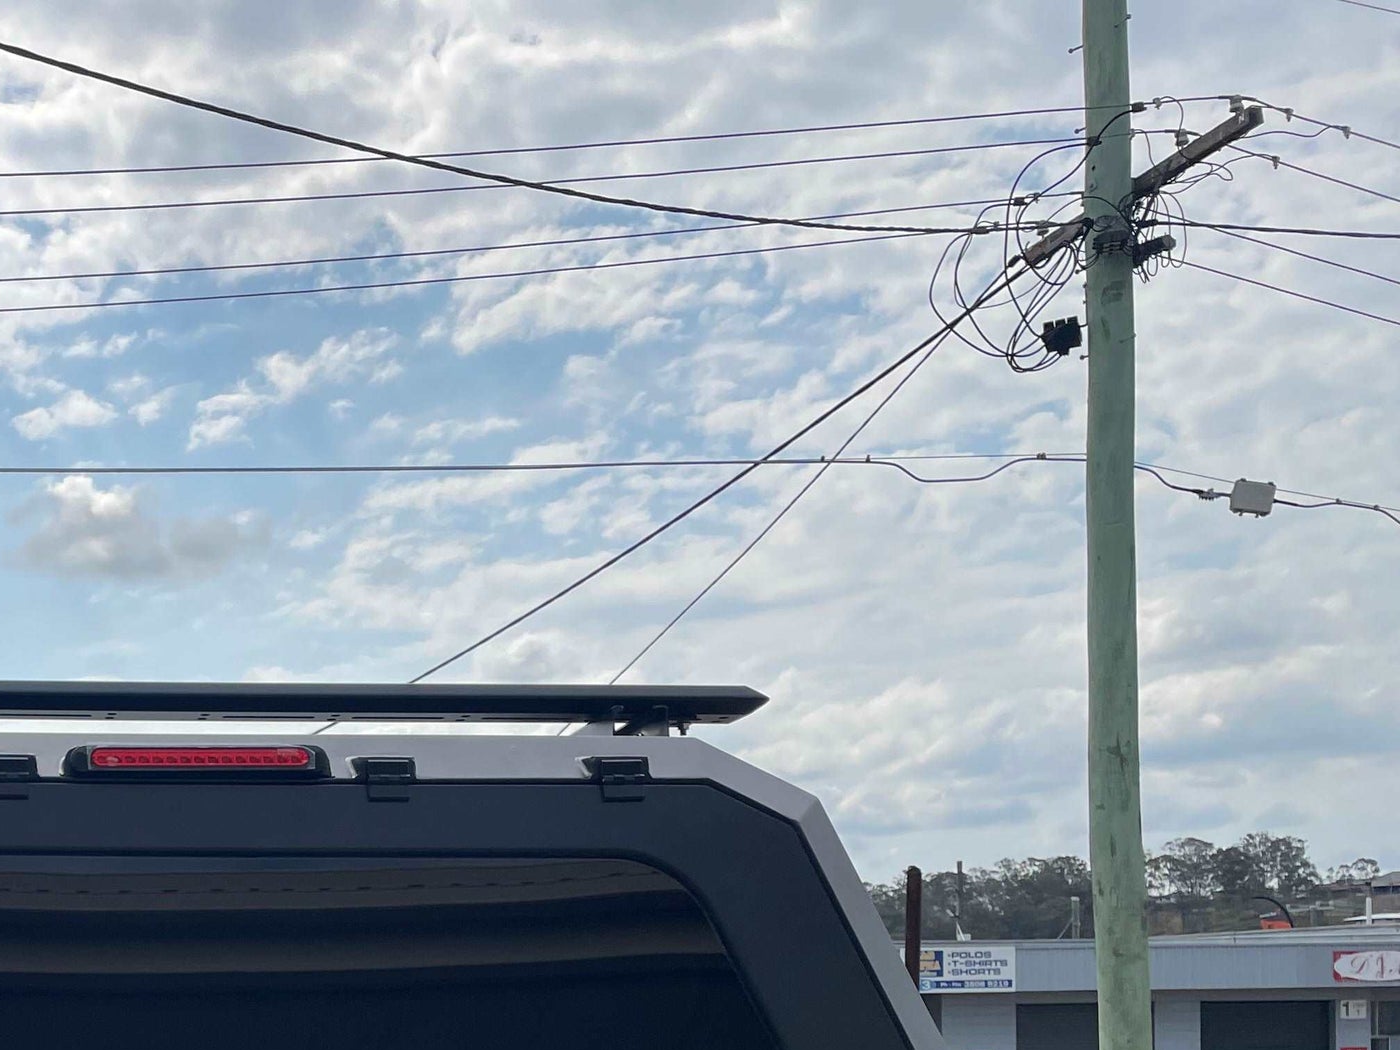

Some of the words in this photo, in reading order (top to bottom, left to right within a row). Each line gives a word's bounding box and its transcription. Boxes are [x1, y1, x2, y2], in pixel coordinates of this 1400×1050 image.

[951, 951, 992, 959] POLOS
[951, 968, 1001, 976] SHORTS
[1342, 1001, 1350, 1017] 1
